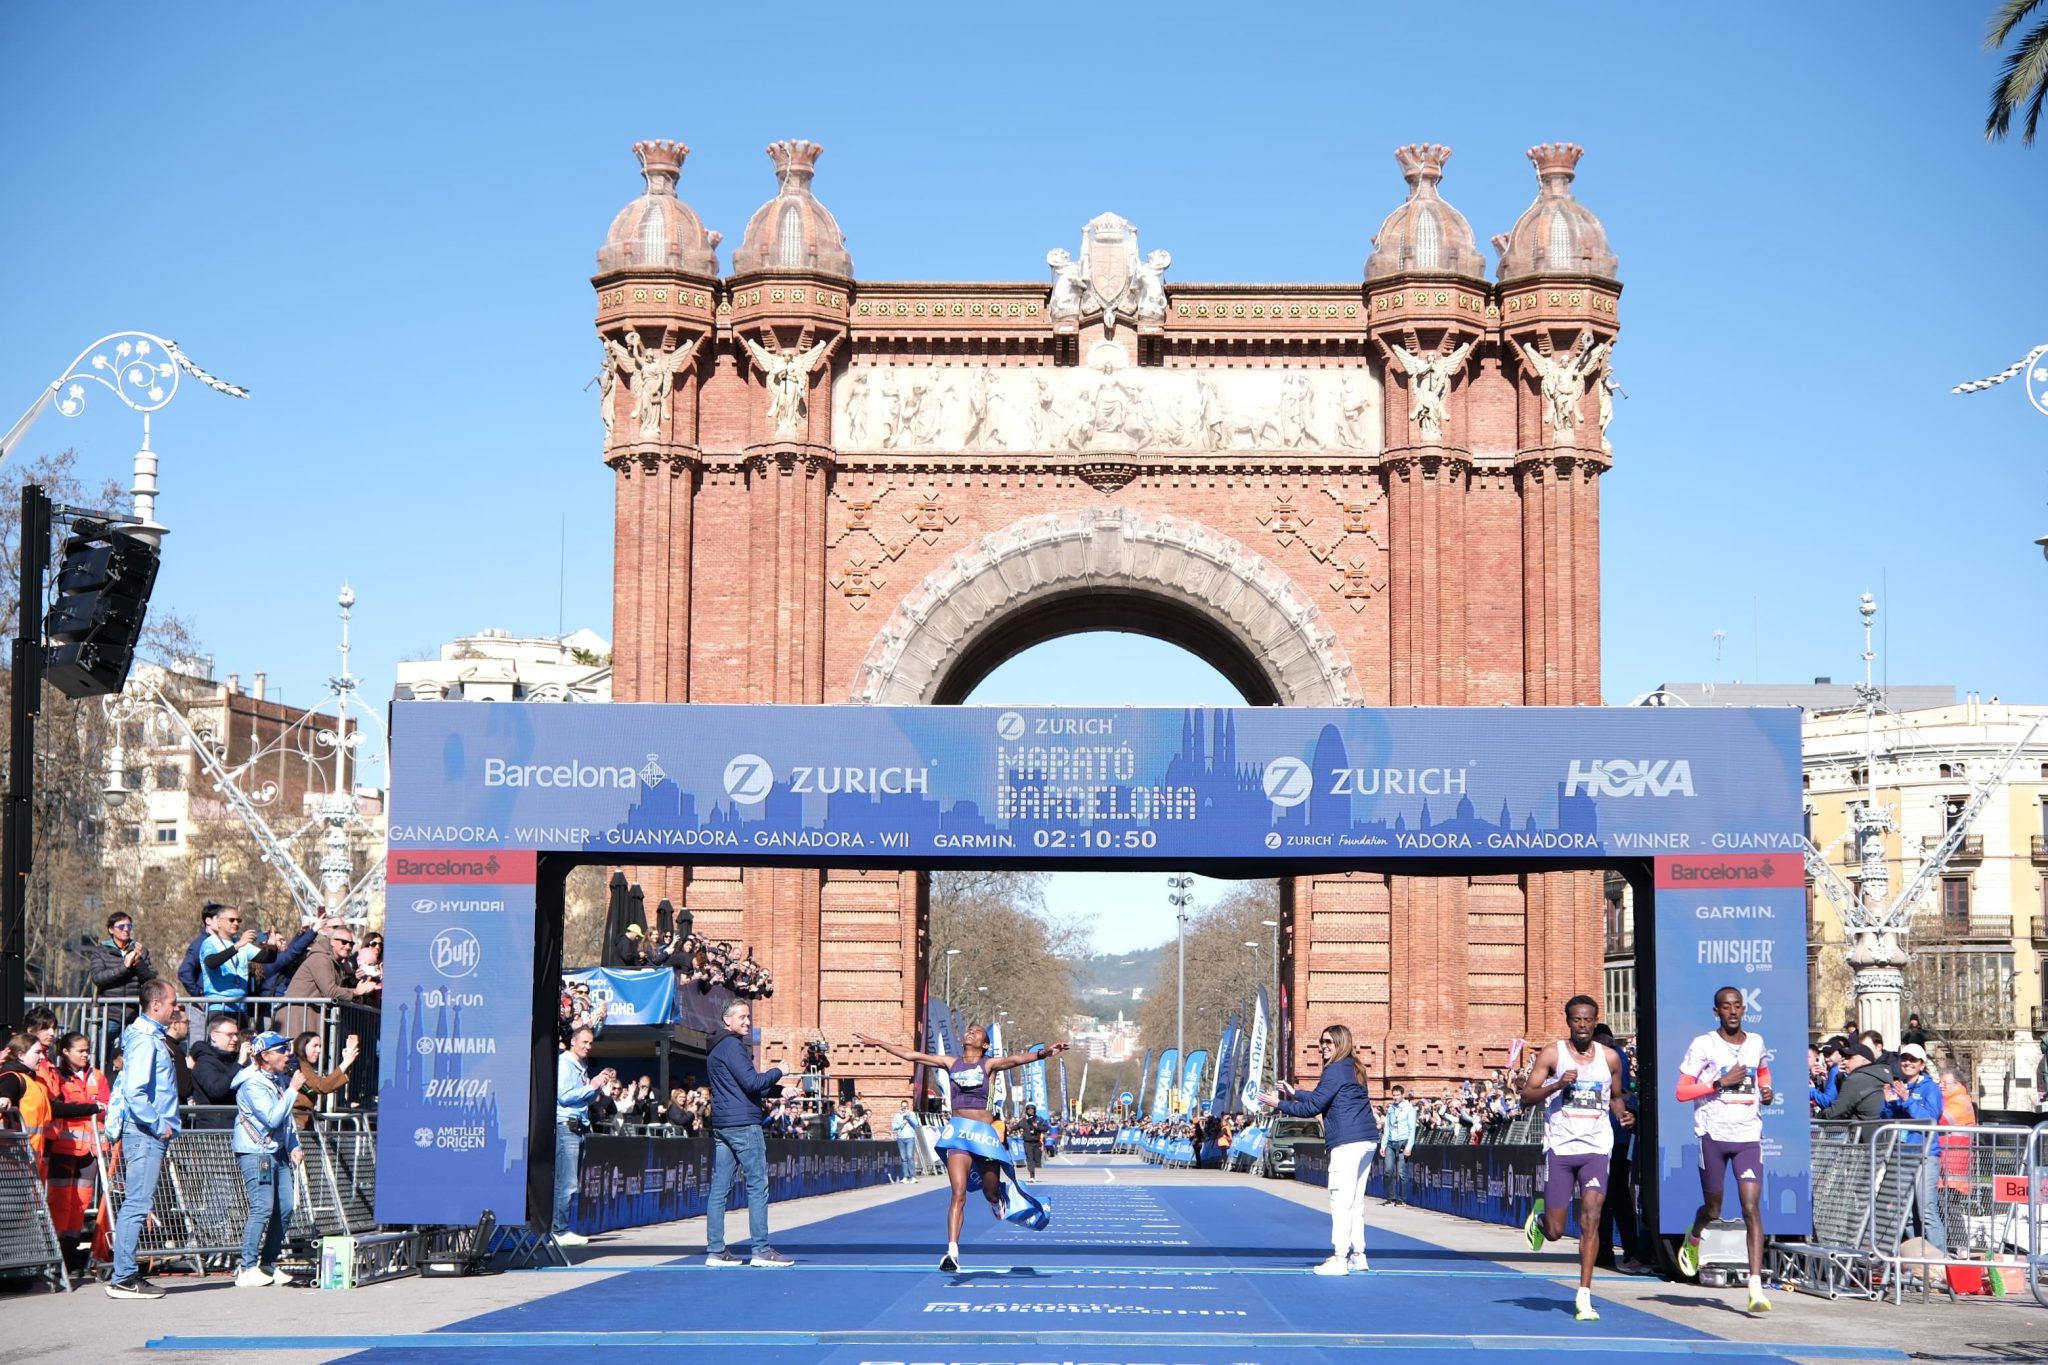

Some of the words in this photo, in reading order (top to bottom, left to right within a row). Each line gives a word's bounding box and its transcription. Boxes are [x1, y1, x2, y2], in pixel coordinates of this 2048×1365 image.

[1035, 718, 1113, 735] ZURICH
[997, 740, 1135, 781] MARATÓ
[484, 758, 636, 788] Barcelona
[789, 766, 929, 794] ZURICH
[1329, 767, 1468, 795] ZURICH
[1564, 759, 1695, 797] HOKA
[997, 785, 1197, 820] BARCELONA
[388, 826, 500, 843] GANADORA
[514, 827, 591, 844] WINNER
[606, 828, 739, 846] GUANYADORA
[754, 831, 865, 848] GANADORA
[1033, 829, 1157, 849] 02:10:50
[1286, 835, 1332, 846] ZURICH
[1338, 833, 1389, 846] Foundation
[1395, 833, 1473, 849] YADORA
[1487, 832, 1599, 849] GANADORA
[1613, 832, 1690, 849] WINNER
[396, 859, 484, 876] Barcelona
[1670, 863, 1759, 881] Barcelona
[440, 901, 504, 912] HYUNDAI
[436, 936, 477, 969] Buff
[1698, 939, 1773, 964] FINISHER
[447, 990, 484, 1007] i-run
[435, 1037, 497, 1054] YAMAHA
[425, 1079, 490, 1098] BIKKOA
[437, 1126, 485, 1136] AMETLLER
[957, 1129, 1000, 1148] ZURICH
[436, 1136, 485, 1149] ORIGEN
[1087, 1136, 1114, 1147] progress
